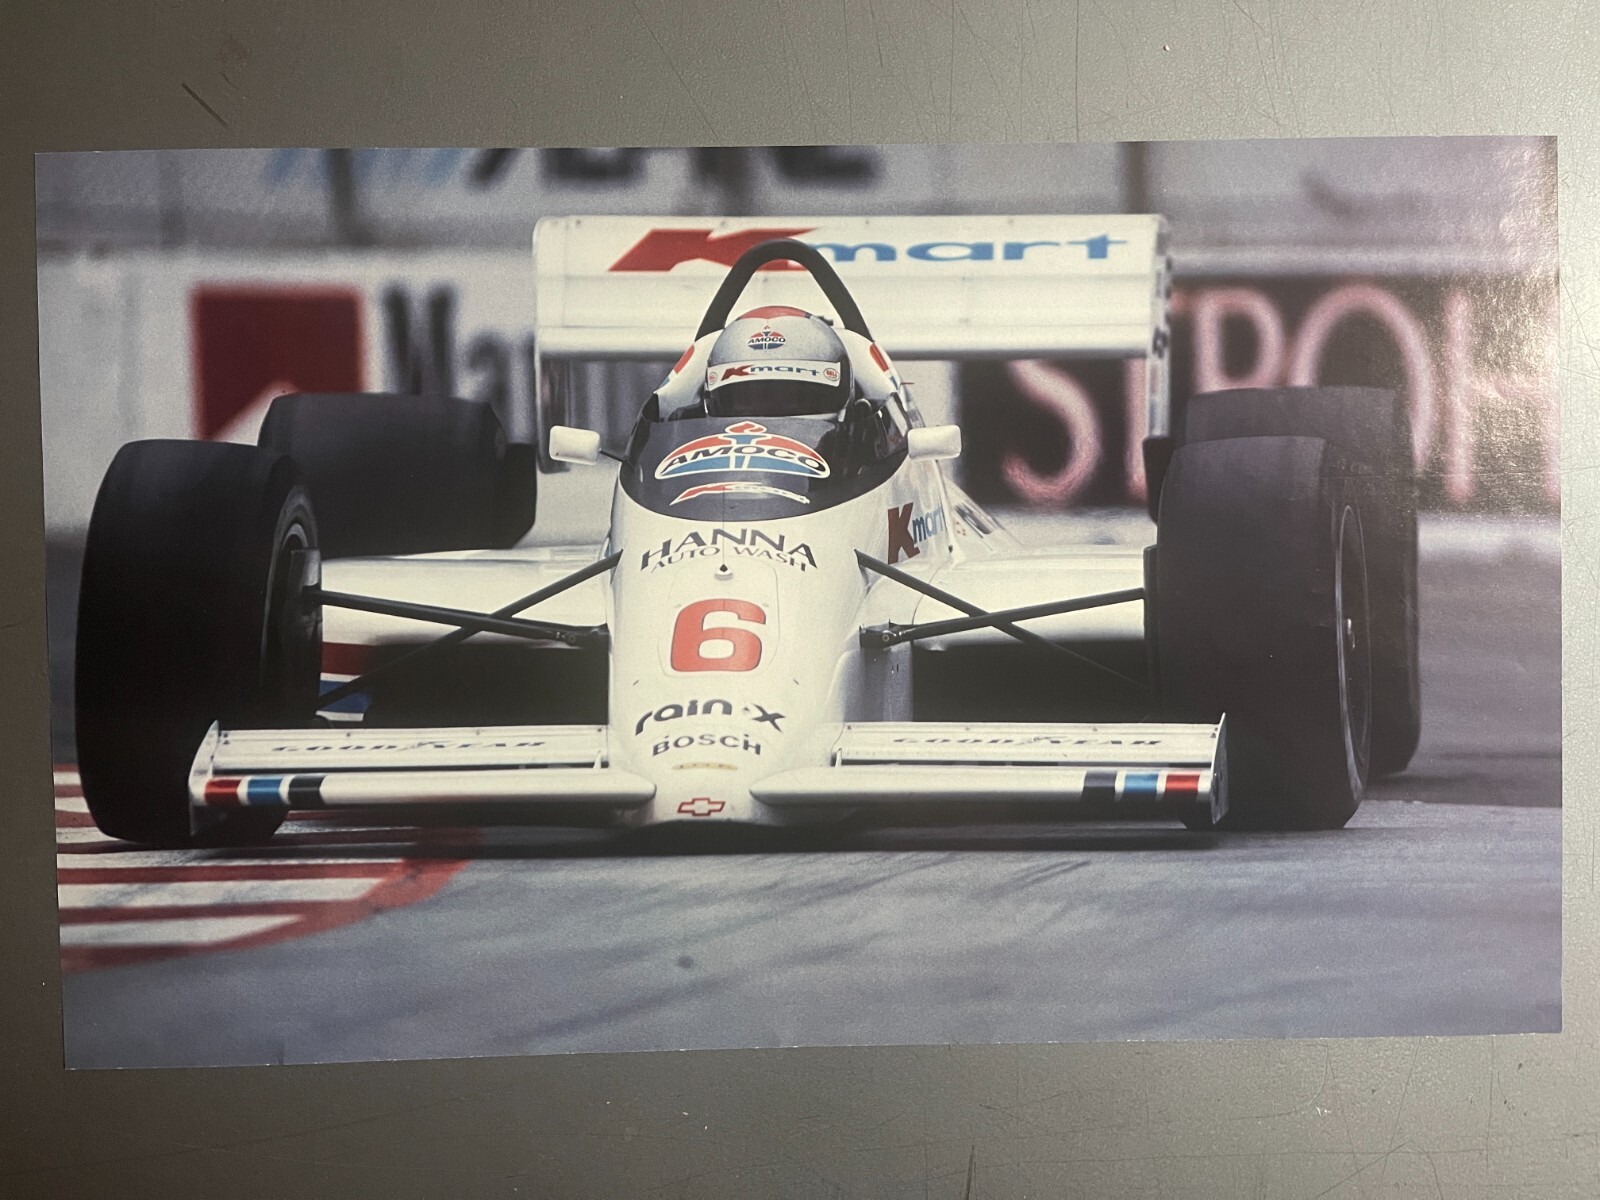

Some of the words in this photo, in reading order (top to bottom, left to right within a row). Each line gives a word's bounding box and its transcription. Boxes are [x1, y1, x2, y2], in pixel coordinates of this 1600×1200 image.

[748, 336, 786, 344] AMOCO
[721, 364, 820, 381] Kmart
[659, 445, 827, 476] AMOCO
[640, 528, 818, 572] HANNA
[651, 546, 720, 573] AUTO
[733, 546, 807, 572] WASH
[670, 598, 767, 672] 6
[652, 733, 761, 756] BOSCH
